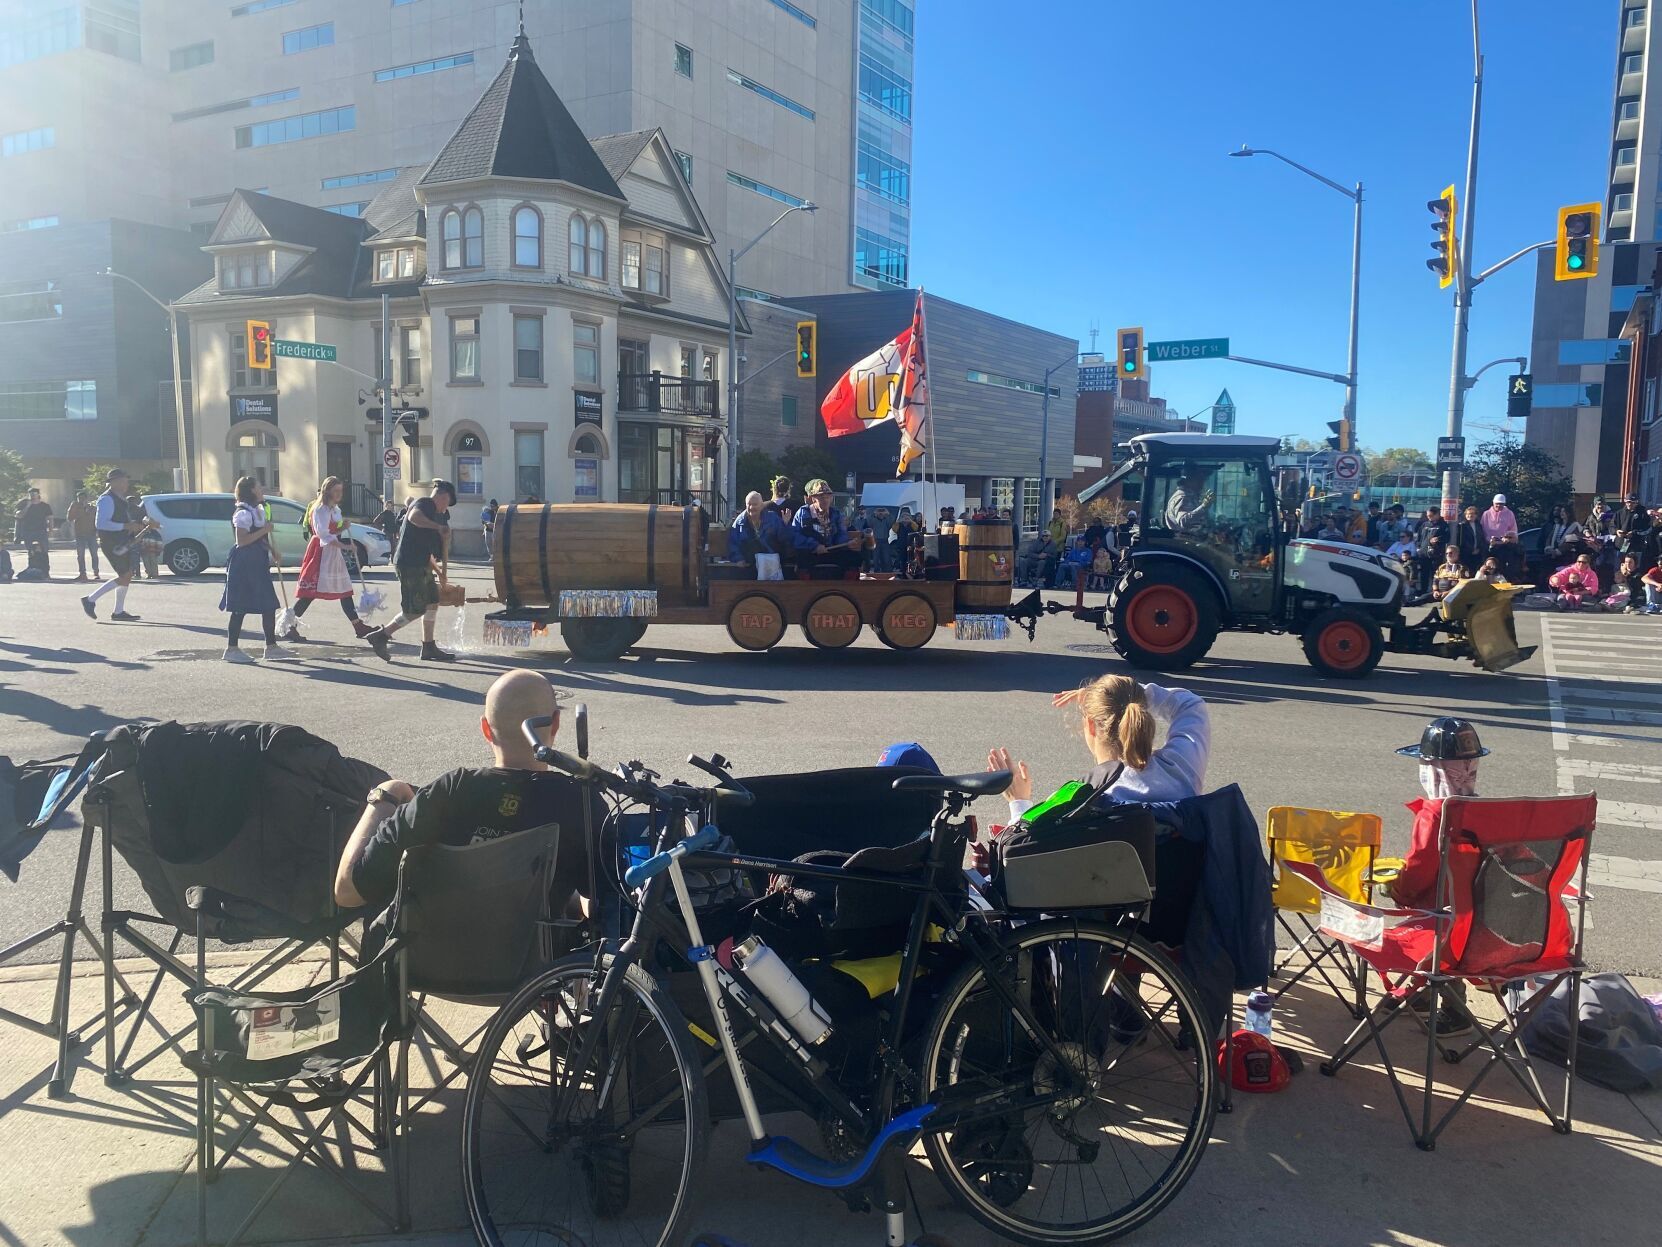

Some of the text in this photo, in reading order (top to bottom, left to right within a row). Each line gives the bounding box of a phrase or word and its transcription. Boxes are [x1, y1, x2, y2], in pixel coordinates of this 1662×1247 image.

[276, 343, 327, 359] Frederick
[1156, 344, 1207, 358] Weber
[465, 438, 475, 446] 97
[740, 613, 928, 629] TAP THAT KEG
[474, 826, 500, 837] JOIN
